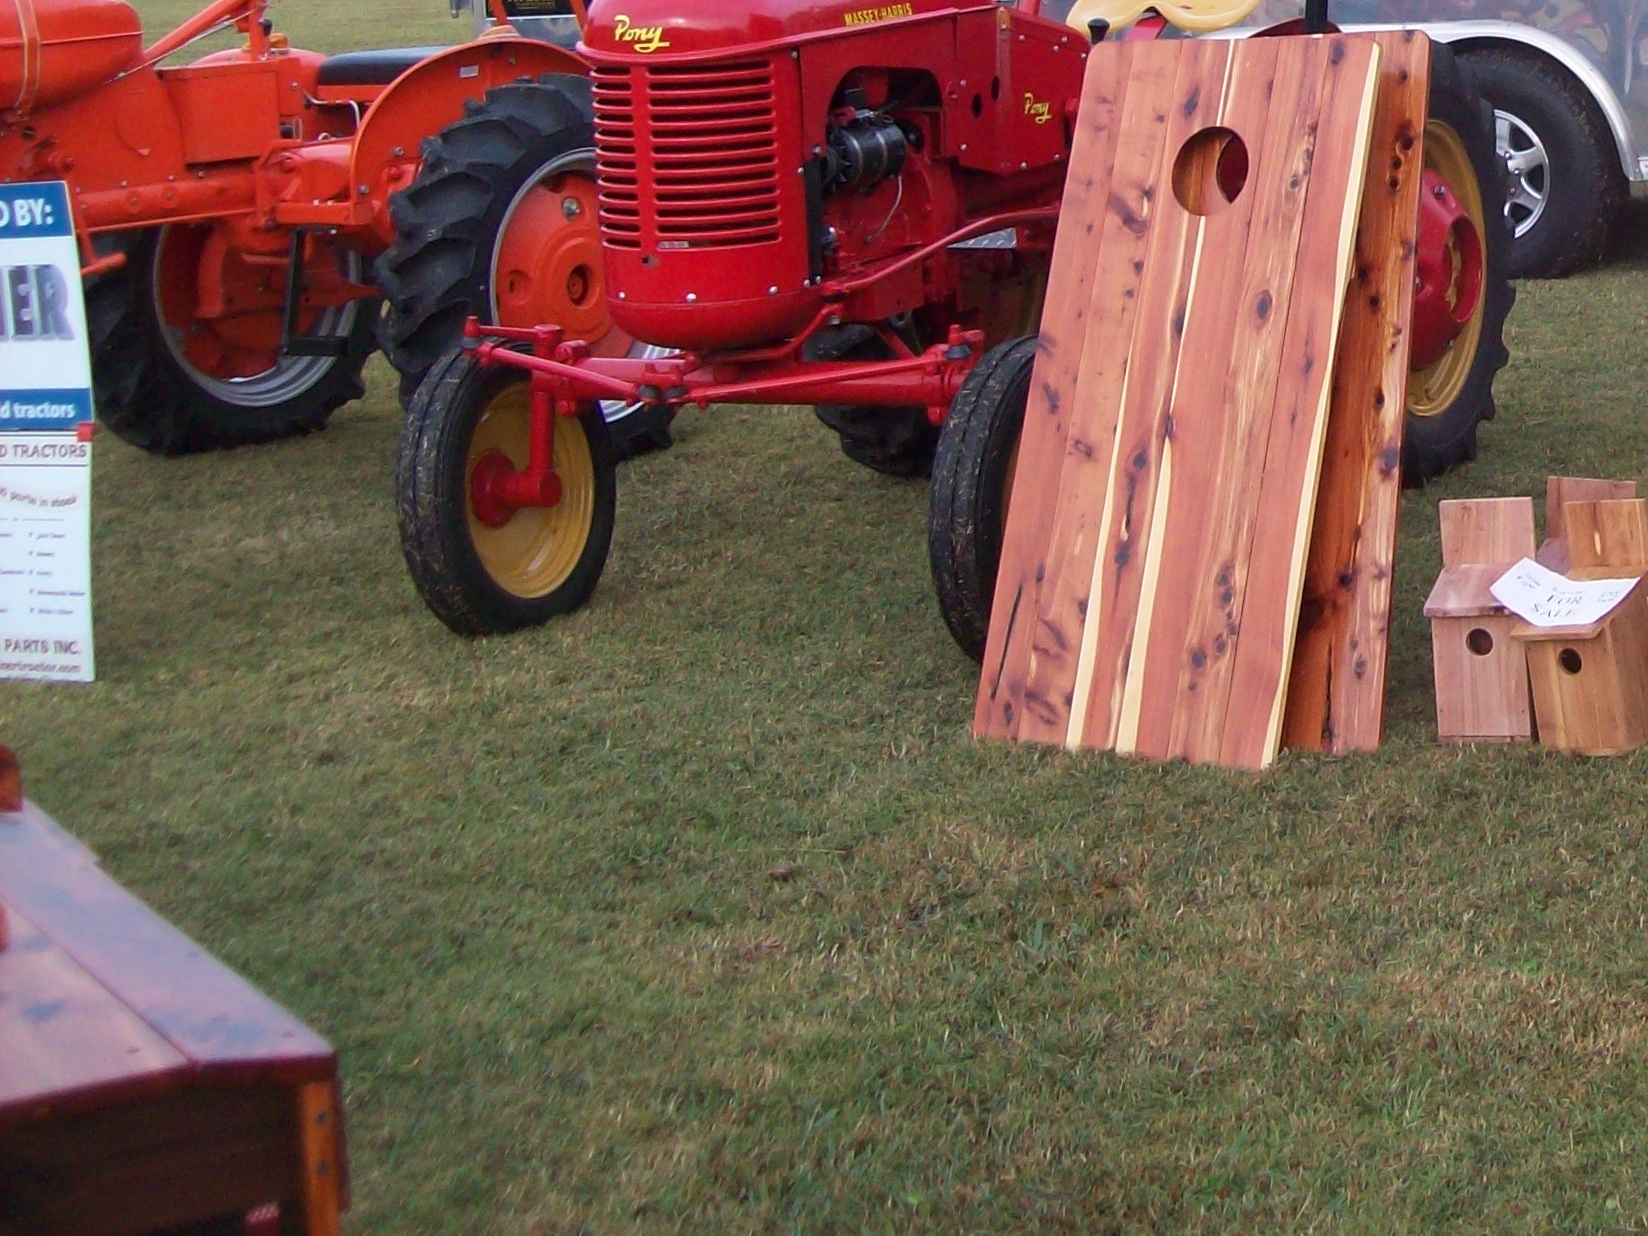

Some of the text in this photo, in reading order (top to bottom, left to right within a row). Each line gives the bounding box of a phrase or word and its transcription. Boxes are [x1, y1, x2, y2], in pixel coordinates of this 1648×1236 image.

[844, 2, 913, 28] MASSEY-HARRIS
[614, 14, 670, 53] Pony
[1024, 92, 1052, 124] Pony
[14, 197, 54, 227] BY:
[13, 401, 76, 420] tractors
[13, 444, 87, 459] TRACTORS
[5, 638, 49, 653] PARTS
